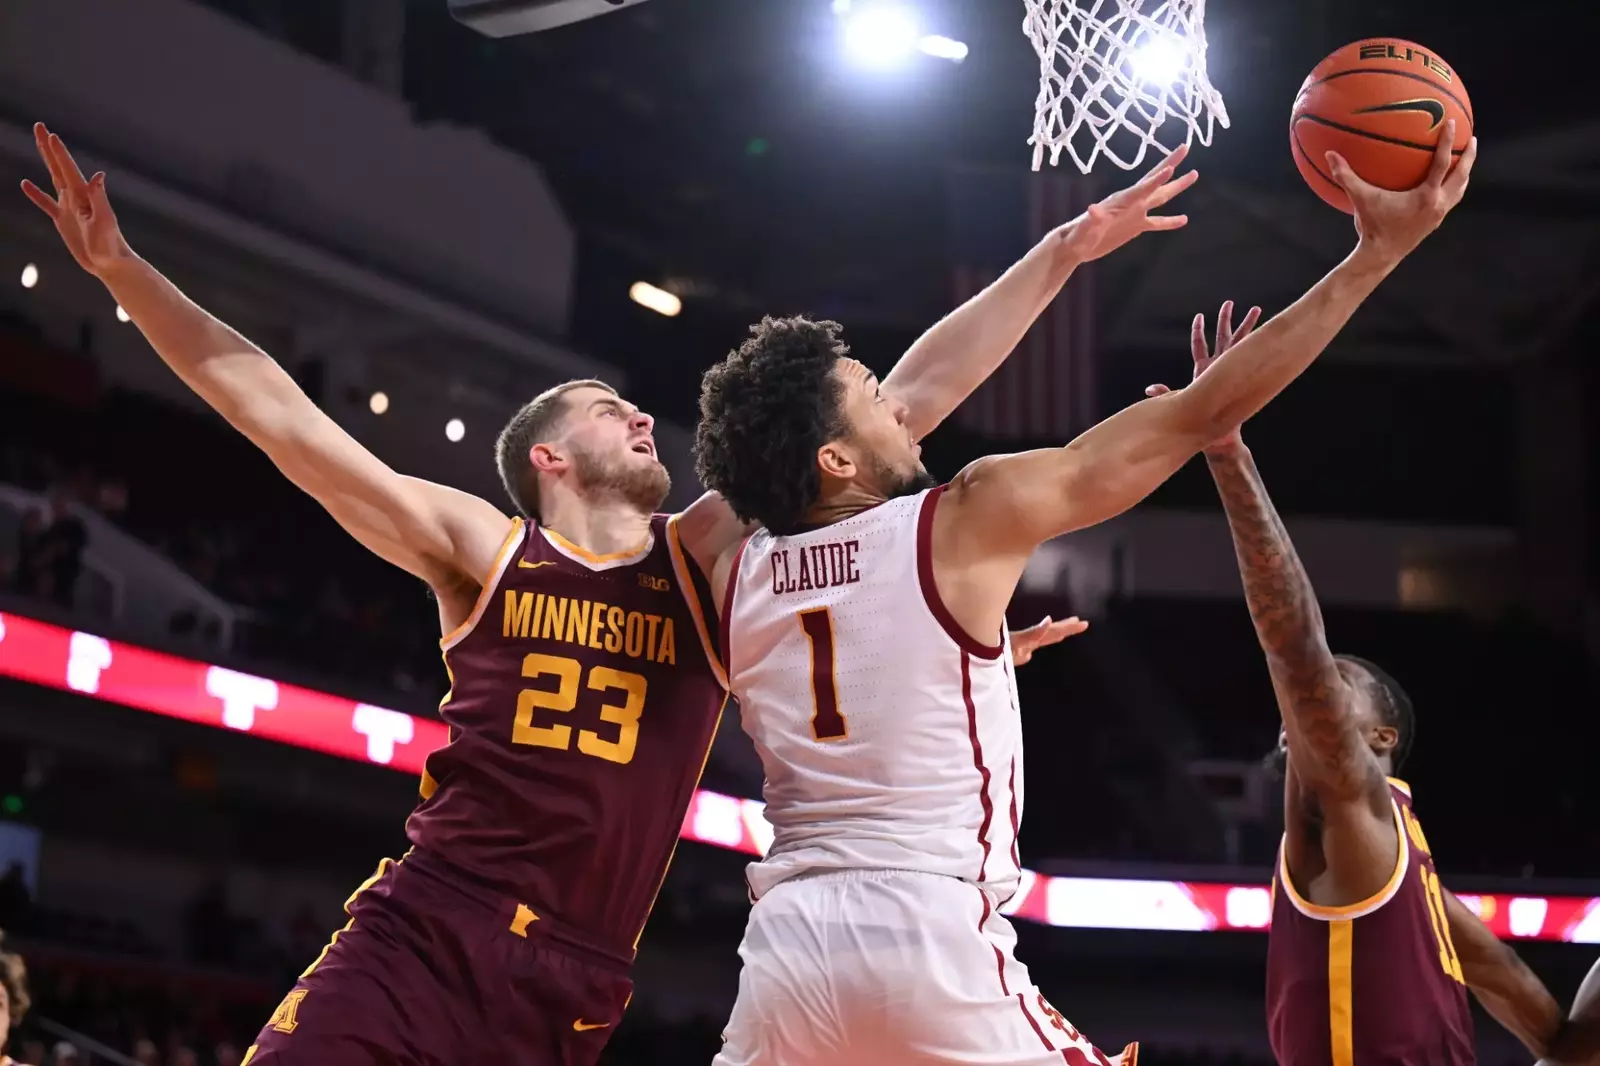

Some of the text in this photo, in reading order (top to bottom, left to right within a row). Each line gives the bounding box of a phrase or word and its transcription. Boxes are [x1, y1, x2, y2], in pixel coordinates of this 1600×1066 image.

[1360, 45, 1451, 83] ELITE
[771, 540, 860, 595] CLAUDE
[503, 590, 676, 665] MINNESOTA
[512, 653, 647, 764] 23
[796, 606, 849, 742] 1
